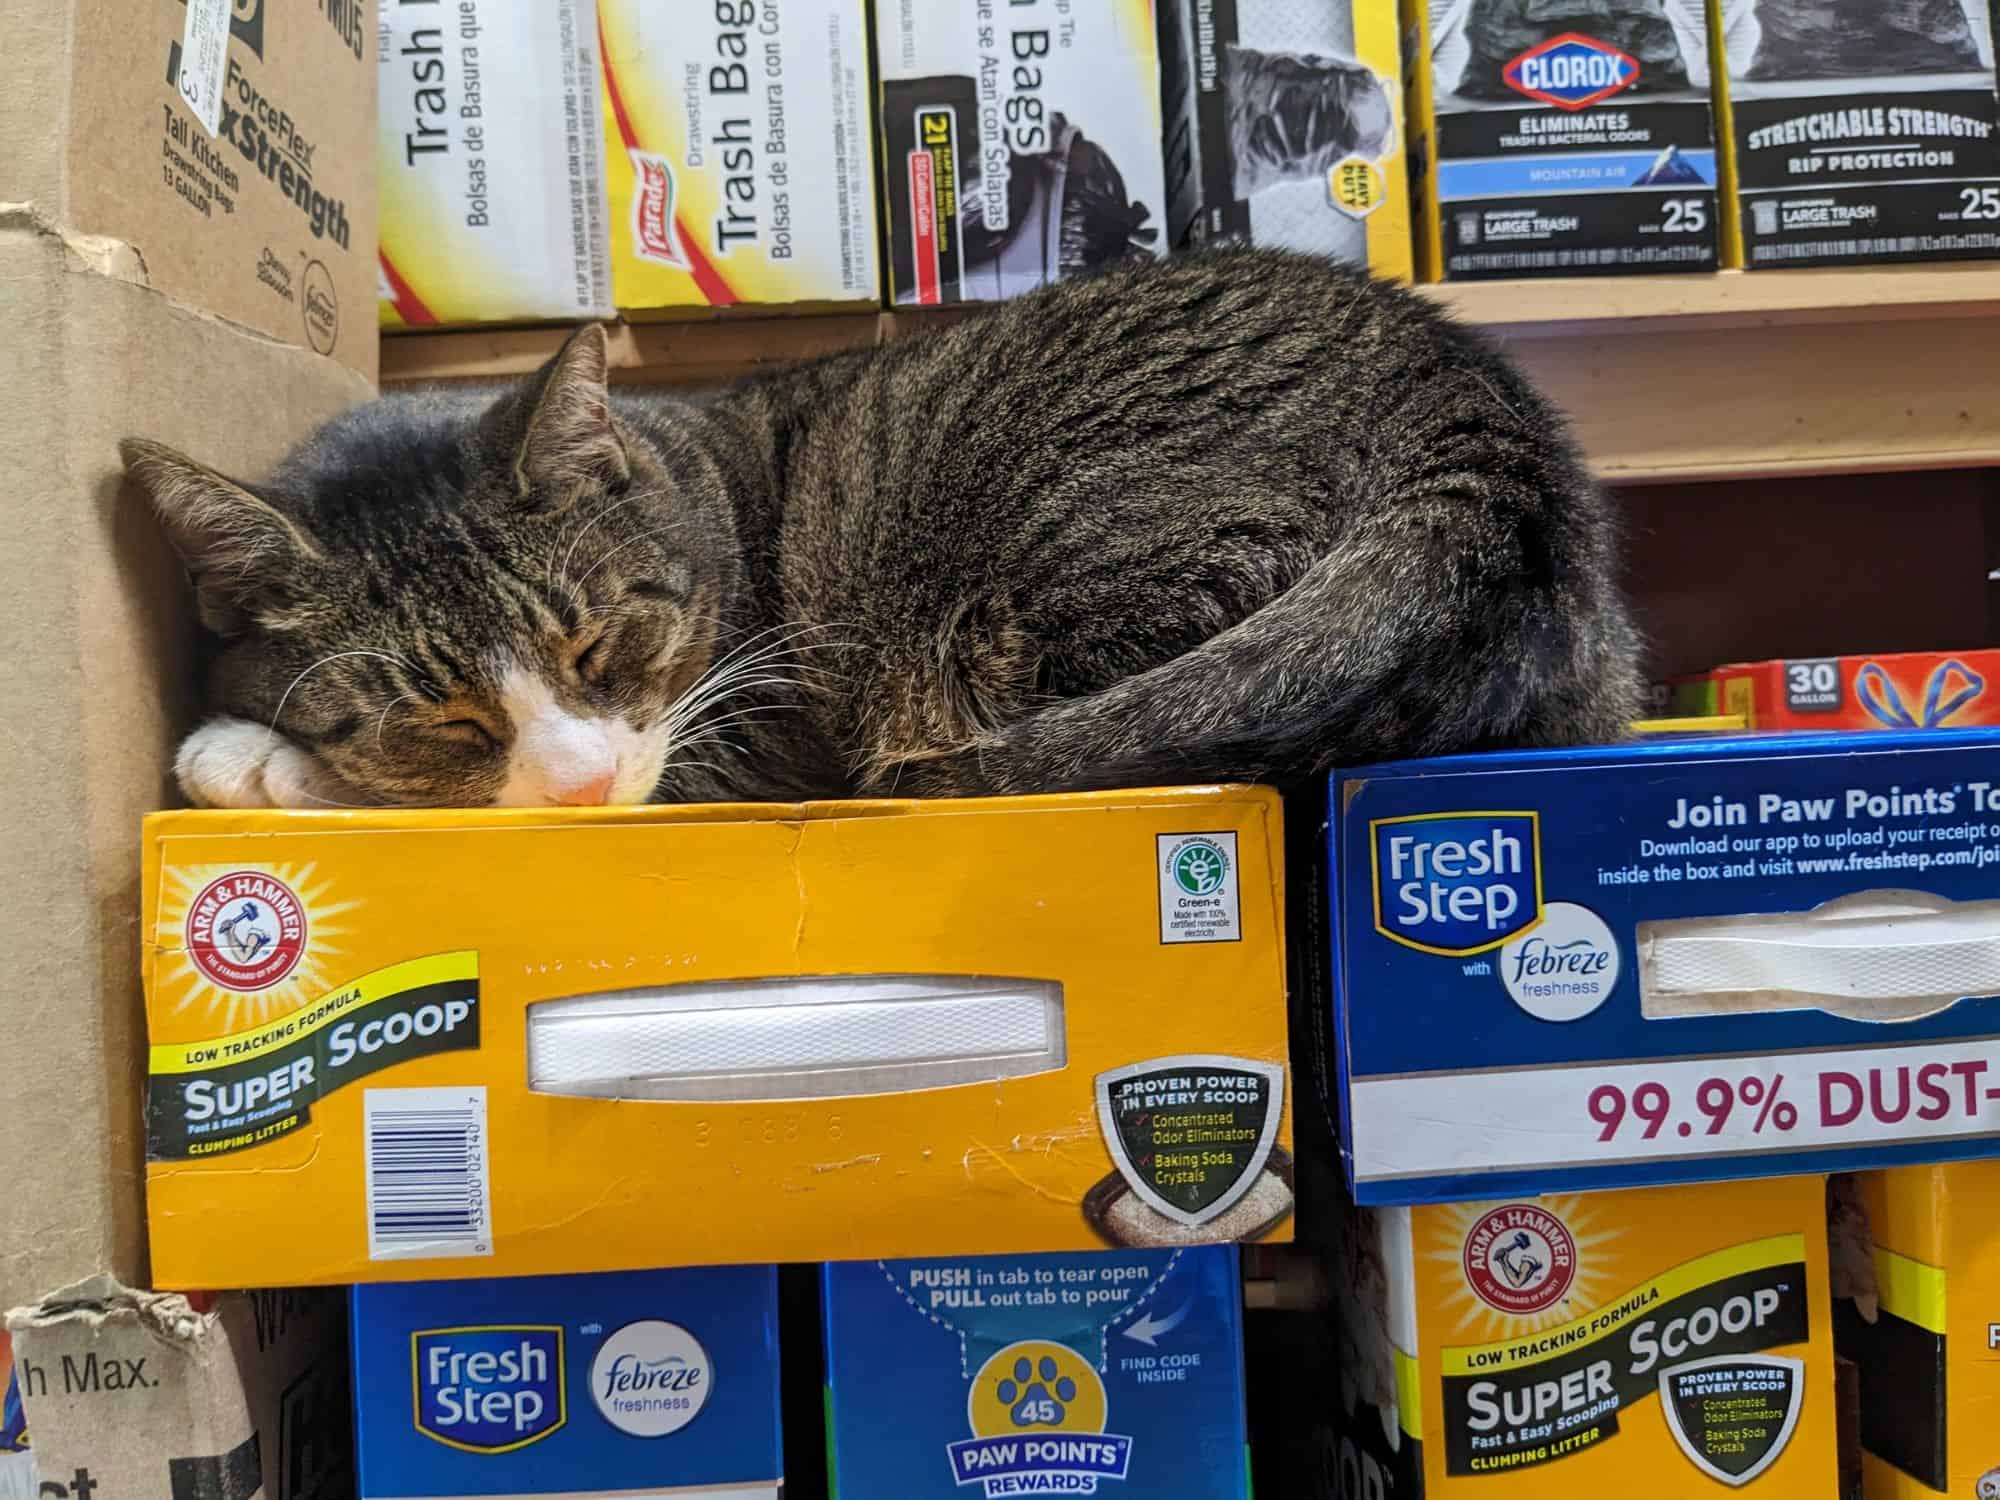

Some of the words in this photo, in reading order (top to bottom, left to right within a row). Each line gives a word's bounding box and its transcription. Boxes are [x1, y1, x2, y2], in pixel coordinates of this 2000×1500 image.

[459, 2, 477, 39] que
[978, 25, 994, 48] se
[1059, 18, 1075, 48] Tie
[766, 43, 781, 76] con
[1520, 53, 1624, 89] CLOROX
[460, 46, 482, 119] Basura
[980, 56, 998, 101] Atan
[1005, 29, 1050, 150] Bags
[226, 58, 316, 168] ForceFlex
[401, 28, 449, 166] Trash
[684, 62, 704, 167] Drawstring
[766, 84, 785, 155] Basura
[924, 114, 948, 144] 21
[983, 103, 998, 137] con
[1519, 113, 1630, 134] ELIMINATES
[1748, 108, 1884, 150] STRETCHABLE
[1888, 108, 1989, 138] STRENGTH
[163, 104, 187, 148] Tall
[192, 130, 239, 193] Kitchen
[463, 125, 484, 152] de
[1548, 132, 1607, 145] BACTERIAL
[1608, 130, 1650, 142] ODORS
[768, 161, 788, 186] de
[1529, 167, 1600, 182] MOUNTAIN
[1604, 165, 1627, 178] AIR
[1788, 156, 1824, 174] RIP
[1828, 151, 1954, 171] PROTECTION
[163, 165, 173, 187] 13
[176, 176, 211, 218] GALLON
[466, 156, 488, 227] Bolsas
[712, 119, 757, 251] Trash
[984, 145, 1005, 226] Solapas
[1343, 165, 1356, 207] DUTY
[1357, 165, 1369, 208] HEAVY
[642, 174, 667, 249] Parade
[1661, 200, 1706, 233] 25
[1782, 207, 1829, 223] LARGE
[1830, 204, 1877, 220] TRASH
[1960, 187, 2000, 220] 25
[771, 191, 792, 259] Bolsas
[1484, 218, 1531, 236] LARGE
[1532, 216, 1579, 233] TRASH
[1788, 664, 1836, 693] 30
[1790, 693, 1837, 705] GALLON
[1667, 797, 1746, 829] Join
[1759, 793, 1835, 823] Paw
[1845, 786, 1956, 819] Points
[1390, 829, 1521, 880] Fresh
[1640, 835, 1728, 857] Download
[1732, 839, 1761, 853] our
[1766, 836, 1798, 856] app
[1803, 831, 1820, 848] to
[1825, 826, 1883, 850] upload
[1887, 829, 1925, 853] your
[1929, 822, 1987, 844] receipt
[1597, 865, 1650, 884] inside
[1654, 864, 1681, 882] the
[1686, 862, 1719, 880] box
[1723, 859, 1755, 878] and
[1759, 858, 1794, 876] visit
[1797, 844, 2000, 875] www.freshstep.com/joi
[193, 896, 220, 943] ARM
[215, 885, 235, 903] &
[234, 878, 300, 940] HAMMER
[1178, 898, 1220, 908] Green-e
[1398, 882, 1518, 930] Step
[1462, 962, 1491, 977] with
[1514, 937, 1609, 983] febreze
[1522, 980, 1599, 998] freshness
[186, 1048, 217, 1064] LOW
[224, 1024, 295, 1055] TRACKING
[299, 989, 362, 1029] FORMULA
[184, 1055, 315, 1122] SUPER
[328, 1000, 470, 1067] SCOOP
[1123, 1077, 1190, 1095] PROVEN
[1196, 1076, 1258, 1089] POWER
[1123, 1098, 1140, 1110] IN
[1145, 1092, 1199, 1107] EVERY
[1203, 1091, 1259, 1104] SCOOP
[1152, 1112, 1234, 1128] Concentrated
[1587, 1073, 1798, 1143] 99.9%
[188, 1133, 253, 1155] CLUMPING
[256, 1115, 298, 1140] LITTER
[1152, 1132, 1183, 1145] Odor
[1187, 1126, 1256, 1144] Eliminators
[1154, 1153, 1199, 1169] Baking
[1202, 1152, 1233, 1165] Soda
[1155, 1169, 1205, 1186] Crystals
[468, 1178, 484, 1226] 33200
[1471, 1228, 1495, 1270] ARM
[1490, 1217, 1507, 1233] &
[1507, 1211, 1569, 1266] HAMMER
[910, 1268, 971, 1288] PUSH
[976, 1269, 995, 1286] in
[999, 1268, 1030, 1285] tab
[1034, 1269, 1054, 1284] to
[1058, 1267, 1096, 1283] tear
[1101, 1265, 1149, 1284] open
[930, 1289, 986, 1308] PULL
[990, 1292, 1022, 1307] out
[1026, 1288, 1057, 1305] tab
[1061, 1289, 1080, 1304] to
[1085, 1287, 1131, 1307] pour
[580, 1323, 602, 1335] with
[1467, 1350, 1503, 1368] LOW
[1508, 1326, 1587, 1361] TRACKING
[1591, 1288, 1659, 1333] FORMULA
[62, 1352, 159, 1394] Max.
[430, 1341, 547, 1385] Fresh
[1120, 1358, 1157, 1370] FIND
[1161, 1354, 1201, 1368] CODE
[1137, 1369, 1186, 1383] INSIDE
[1466, 1360, 1613, 1430] SUPER
[1629, 1288, 1779, 1375] SCOOP
[604, 1354, 701, 1400] febreze
[1679, 1370, 1733, 1386] PROVEN
[1736, 1369, 1785, 1381] POWER
[1679, 1386, 1694, 1397] IN
[1696, 1381, 1739, 1395] EVERY
[1742, 1380, 1786, 1392] SCOOP
[435, 1387, 543, 1431] Step
[613, 1397, 690, 1413] freshness
[1020, 1401, 1056, 1422] 45
[1703, 1397, 1767, 1410] Concentrated
[1704, 1411, 1728, 1424] Odor
[1729, 1408, 1783, 1422] Eliminators
[1471, 1433, 1502, 1449] Fast
[1506, 1431, 1516, 1445] &
[1520, 1426, 1552, 1444] Easy
[1557, 1394, 1620, 1430] Scooping
[1706, 1429, 1740, 1442] Baking
[1742, 1427, 1767, 1440] Soda
[962, 1443, 1020, 1471] PAW
[1025, 1441, 1117, 1466] POINTS
[1471, 1447, 1548, 1470] CLUMPING
[1551, 1428, 1600, 1456] LITTER
[1706, 1441, 1746, 1455] Crystals
[988, 1474, 1095, 1495] REWARDS
